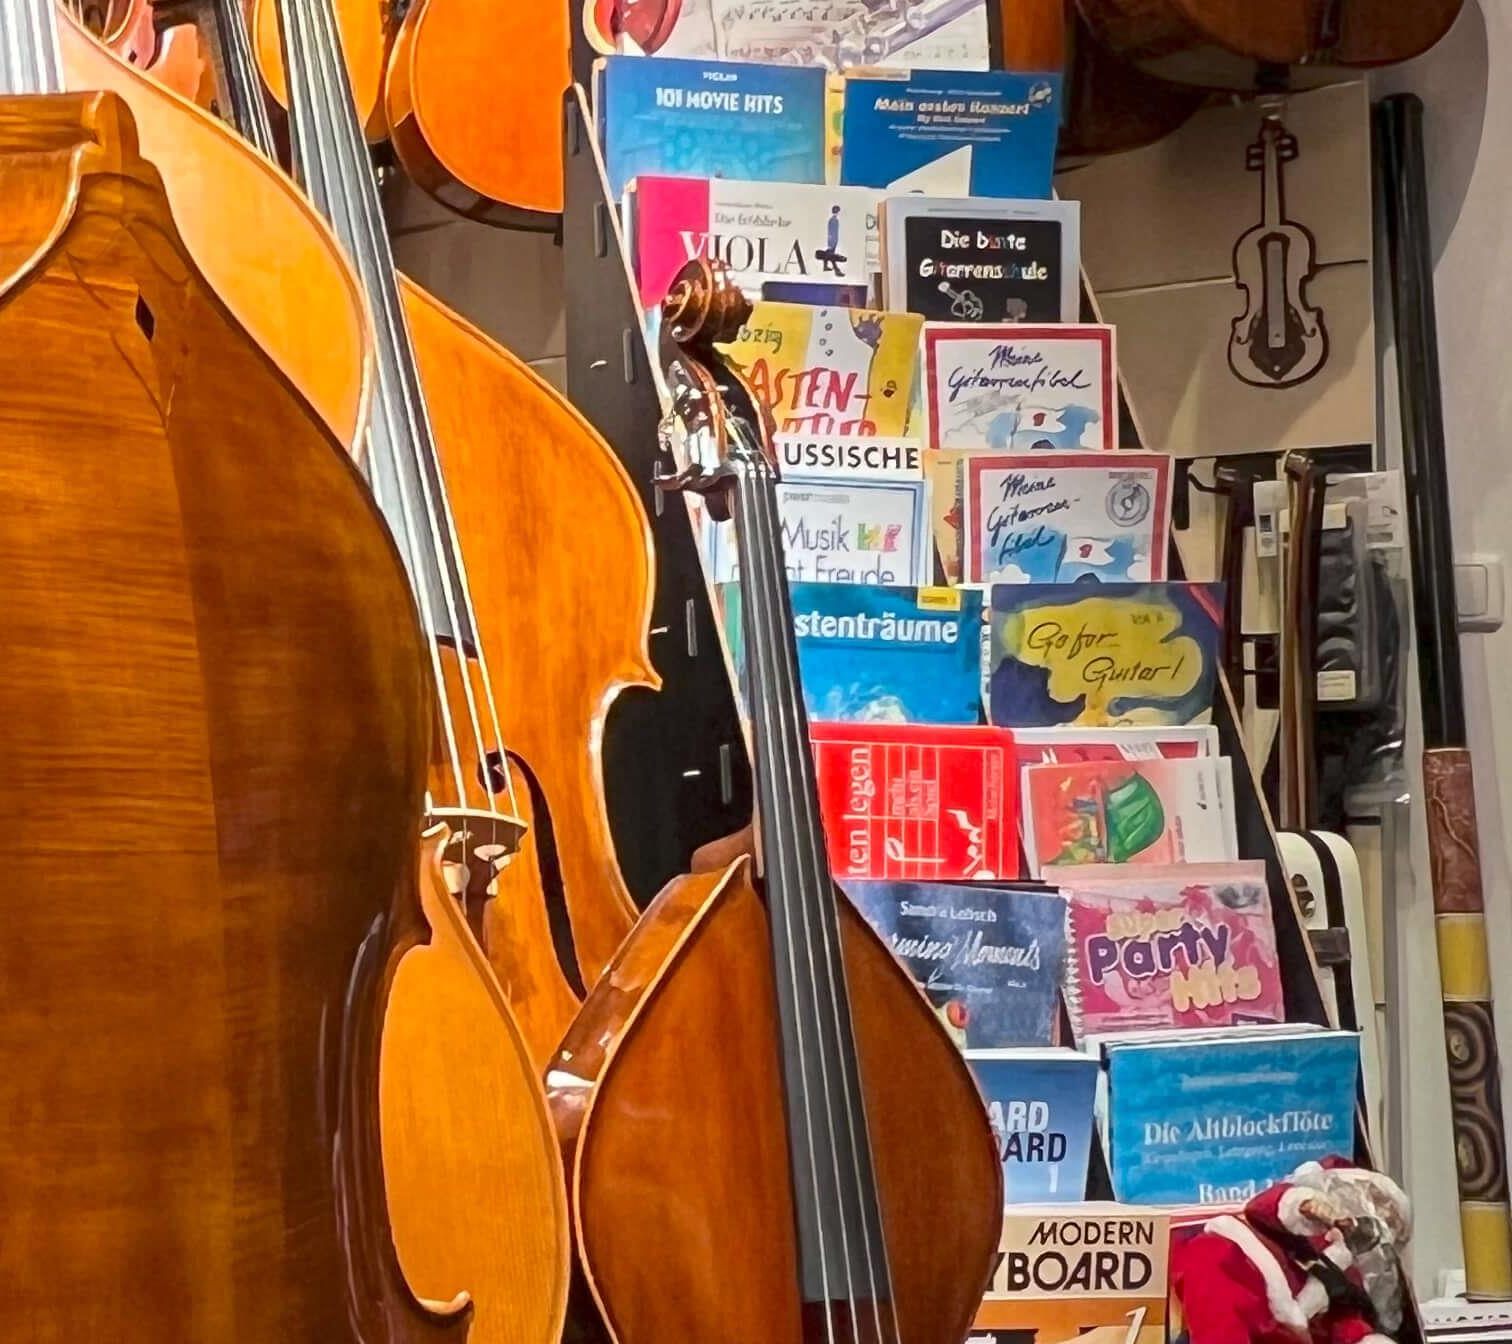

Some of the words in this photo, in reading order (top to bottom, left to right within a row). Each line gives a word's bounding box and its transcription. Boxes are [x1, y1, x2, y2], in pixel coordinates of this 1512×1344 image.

[656, 87, 683, 107] 101
[686, 90, 740, 112] MOVIE
[744, 94, 784, 115] HITS
[874, 96, 915, 113] Mein
[679, 231, 810, 276] VIOLA
[940, 229, 972, 249] Die
[988, 344, 1043, 369] Meine
[745, 357, 873, 413] ASTEN-
[783, 442, 920, 470] USSISCHE
[999, 473, 1057, 502] Meine
[781, 514, 851, 553] Musik
[794, 610, 959, 645] stenträume
[1026, 621, 1065, 658] Go
[1066, 623, 1118, 660] for
[1085, 920, 1231, 986] Party
[989, 1101, 1050, 1134] ARD
[1144, 1122, 1181, 1146] Die
[1187, 1110, 1333, 1142] Altblockflöte
[1002, 1131, 1068, 1163] ARD
[1047, 1165, 1060, 1194] 1
[1028, 1221, 1155, 1246] MODERN
[987, 1250, 1153, 1293] YBOARD
